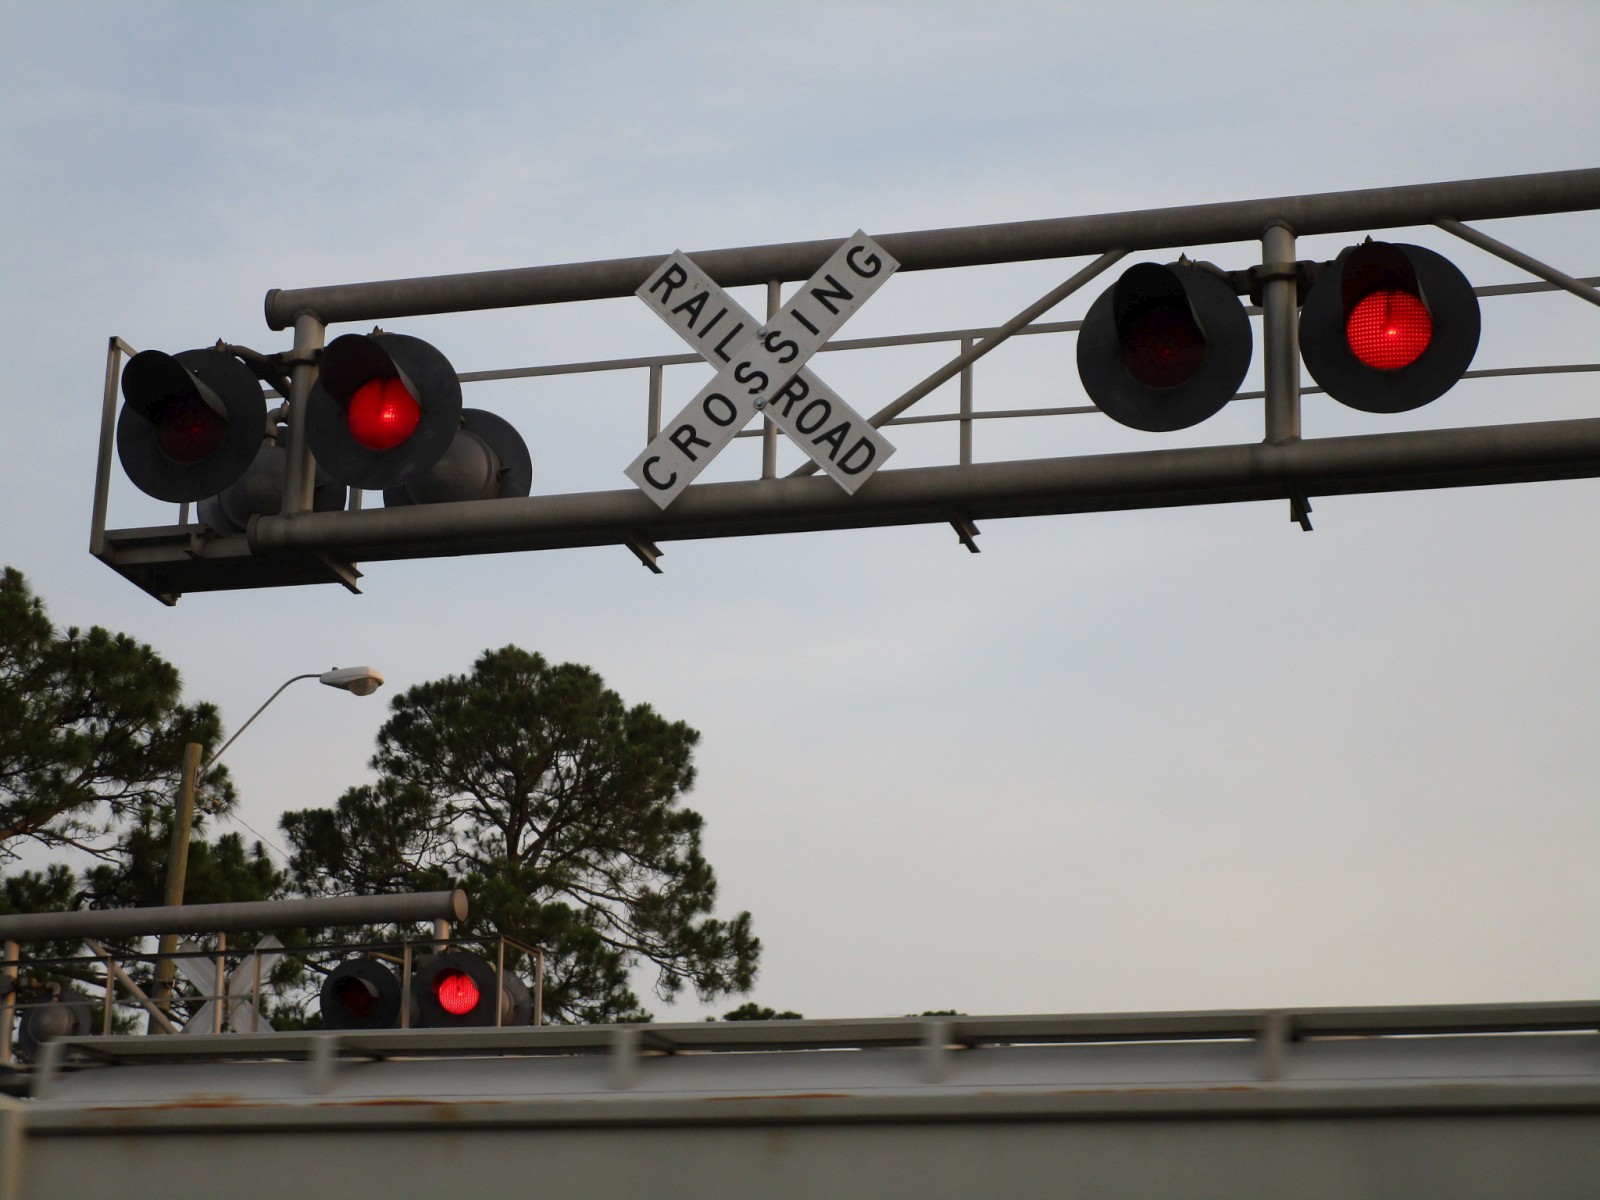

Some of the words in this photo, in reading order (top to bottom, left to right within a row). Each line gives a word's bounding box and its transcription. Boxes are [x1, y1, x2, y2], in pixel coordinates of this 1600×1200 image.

[642, 245, 882, 490] CROSSING
[649, 262, 745, 363] RAIL
[769, 373, 877, 475] ROAD
